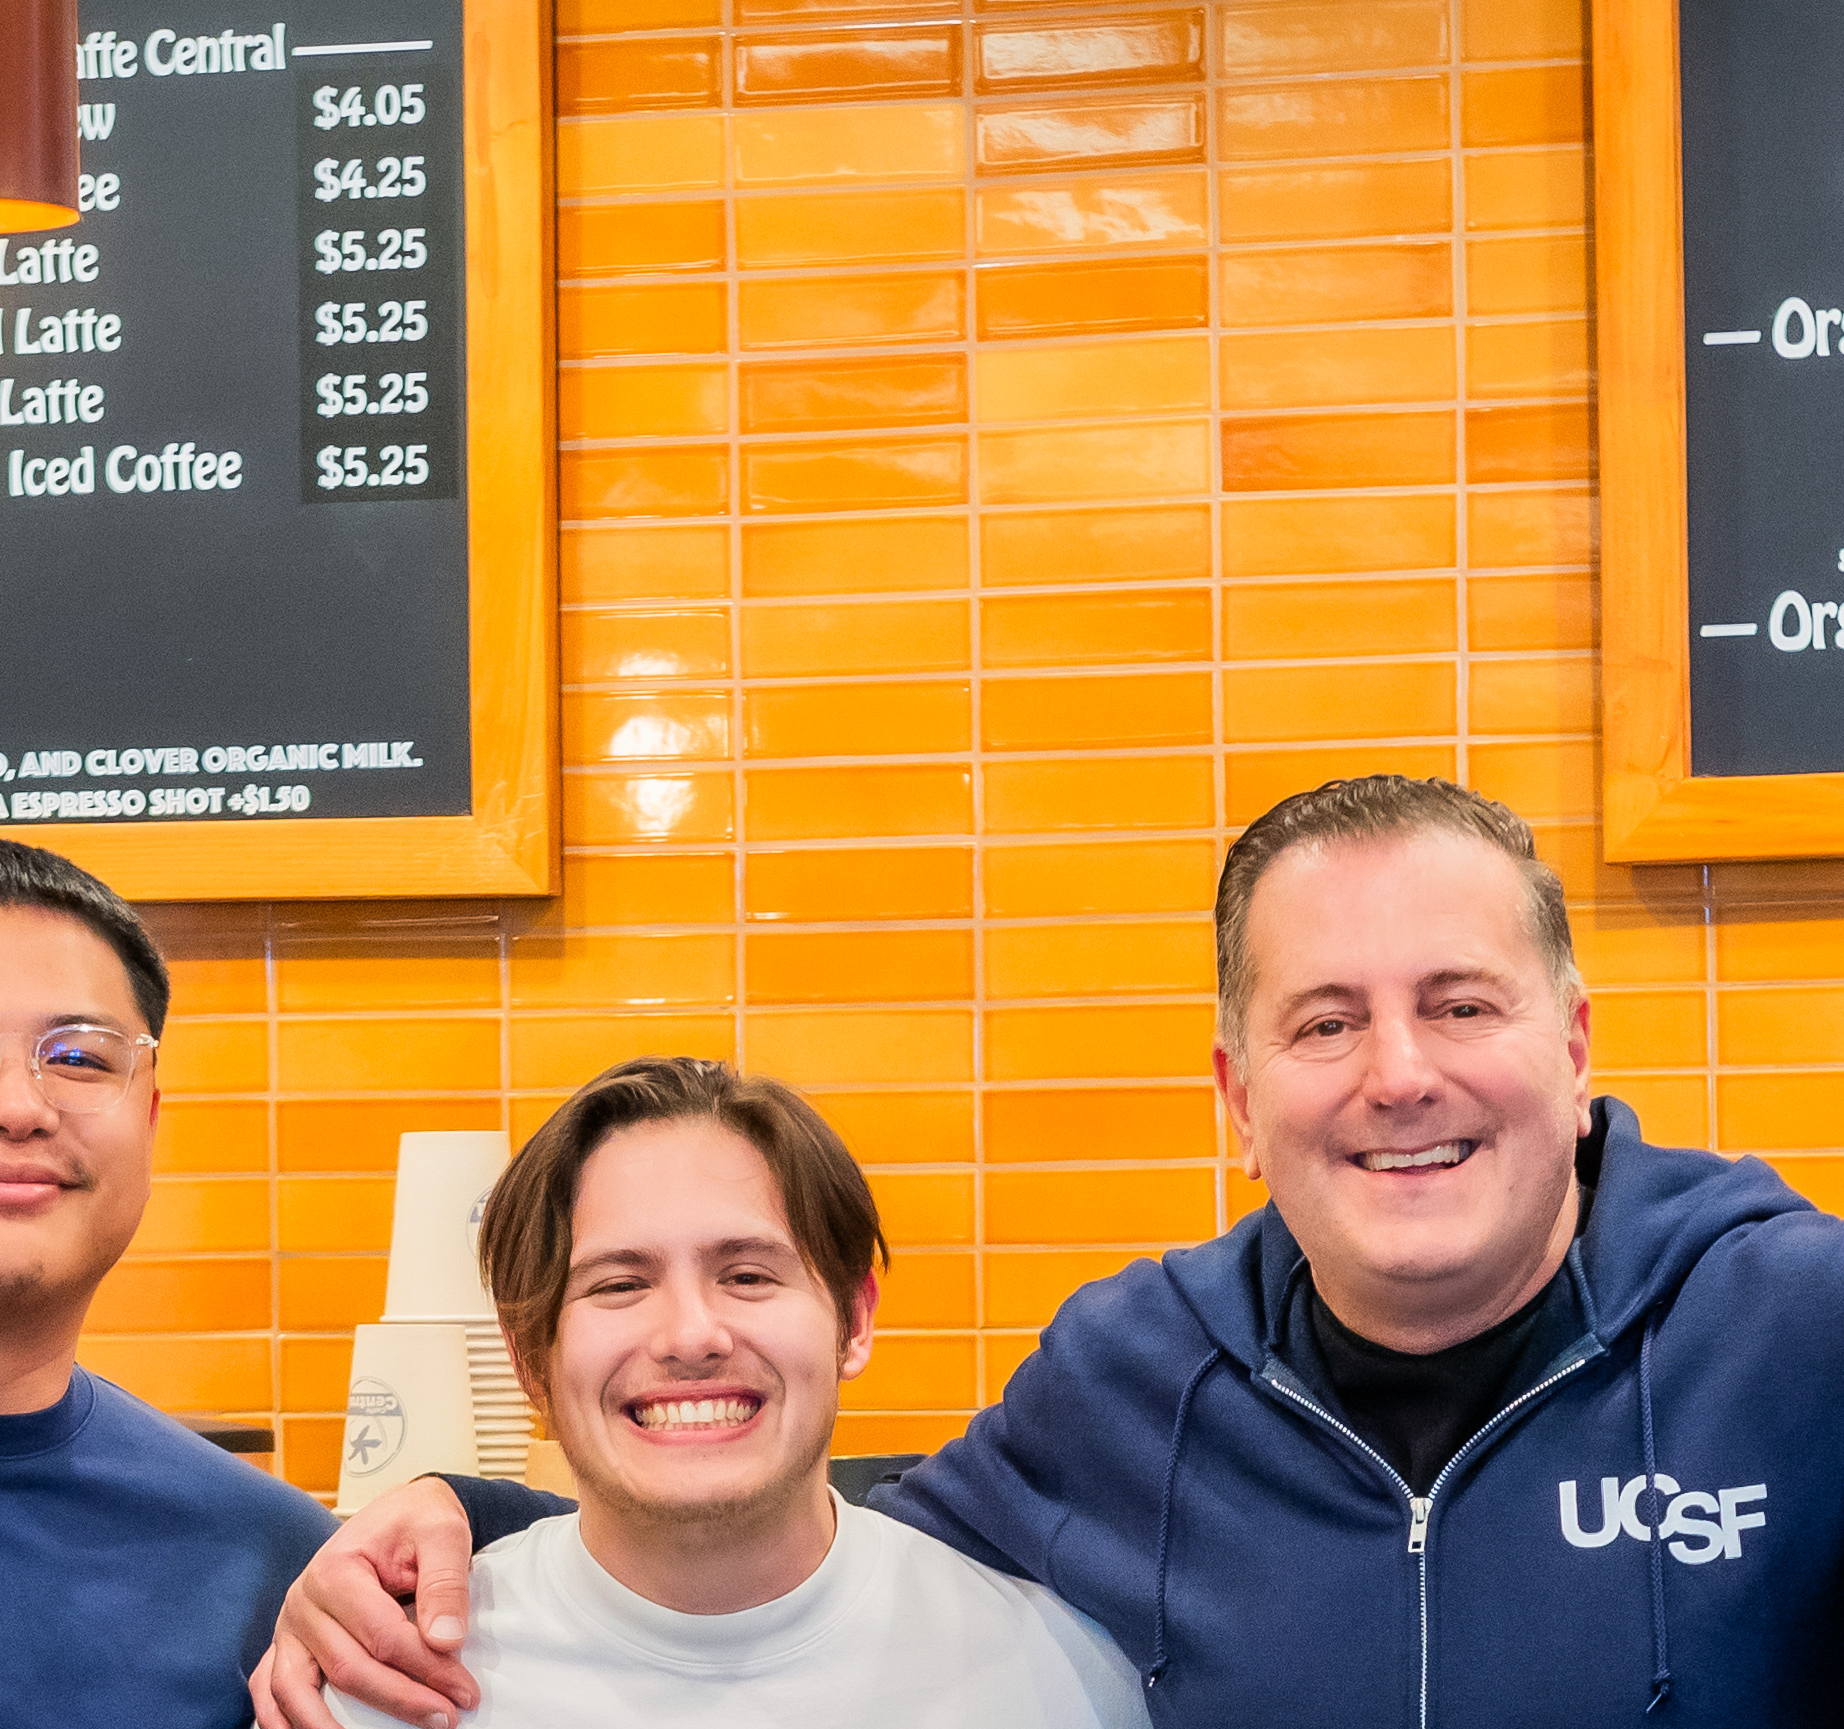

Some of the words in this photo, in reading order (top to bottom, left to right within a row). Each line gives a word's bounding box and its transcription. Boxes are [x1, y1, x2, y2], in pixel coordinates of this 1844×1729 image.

[144, 22, 286, 77] Central
[313, 83, 426, 130] $4.05
[314, 155, 426, 202] $4.25
[315, 227, 427, 274] $5.25
[14, 307, 122, 355] Latte
[316, 300, 428, 346] $5.25
[316, 372, 428, 418] $5.25
[9, 445, 95, 497] Iced
[105, 442, 243, 494] Coffee
[317, 444, 429, 490] $5.25
[18, 750, 82, 778] AND
[85, 747, 200, 776] CLOVER
[202, 744, 340, 773] ORGANIC
[1559, 1473, 1767, 1565] UCSF
